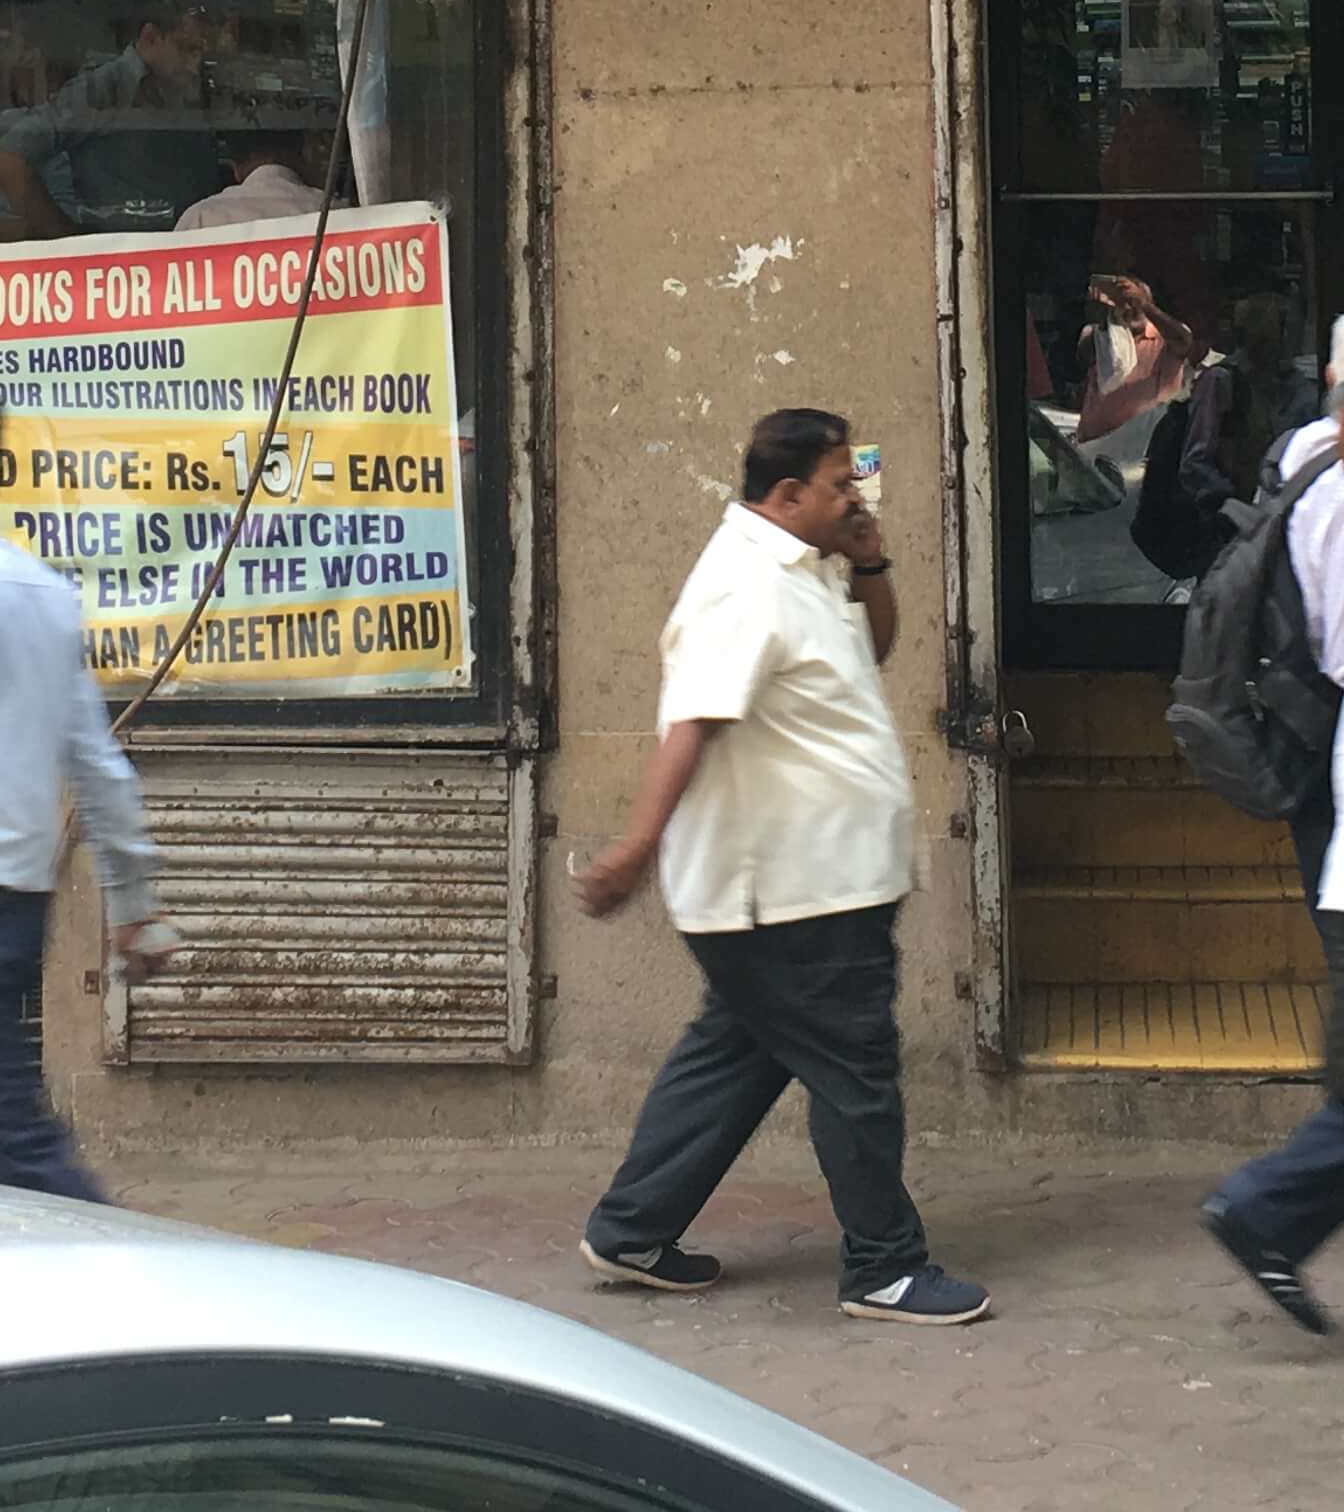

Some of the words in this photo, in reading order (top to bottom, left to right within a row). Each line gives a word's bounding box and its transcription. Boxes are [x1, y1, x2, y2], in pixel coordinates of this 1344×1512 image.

[85, 265, 151, 320] FOR
[163, 259, 222, 314] ALL
[233, 238, 425, 308] OCCASIONS
[29, 339, 185, 373] HARDBOUND
[53, 378, 243, 409] ILLUSTRATIONS
[253, 377, 278, 411] IN
[288, 375, 354, 412] EACH
[363, 373, 432, 414] BOOK
[32, 449, 152, 490] PRICE:
[348, 454, 445, 493] EACH
[14, 511, 123, 557] PRICE
[136, 513, 172, 553] IS
[184, 512, 404, 551] UNMATCHED
[98, 564, 180, 608] ELSE
[191, 559, 225, 601] IN
[239, 558, 306, 595] THE
[320, 552, 448, 589] WORLD
[81, 625, 140, 669] HAN
[152, 624, 173, 666] A
[185, 609, 341, 664] GREETING
[353, 599, 452, 660] CARD)
